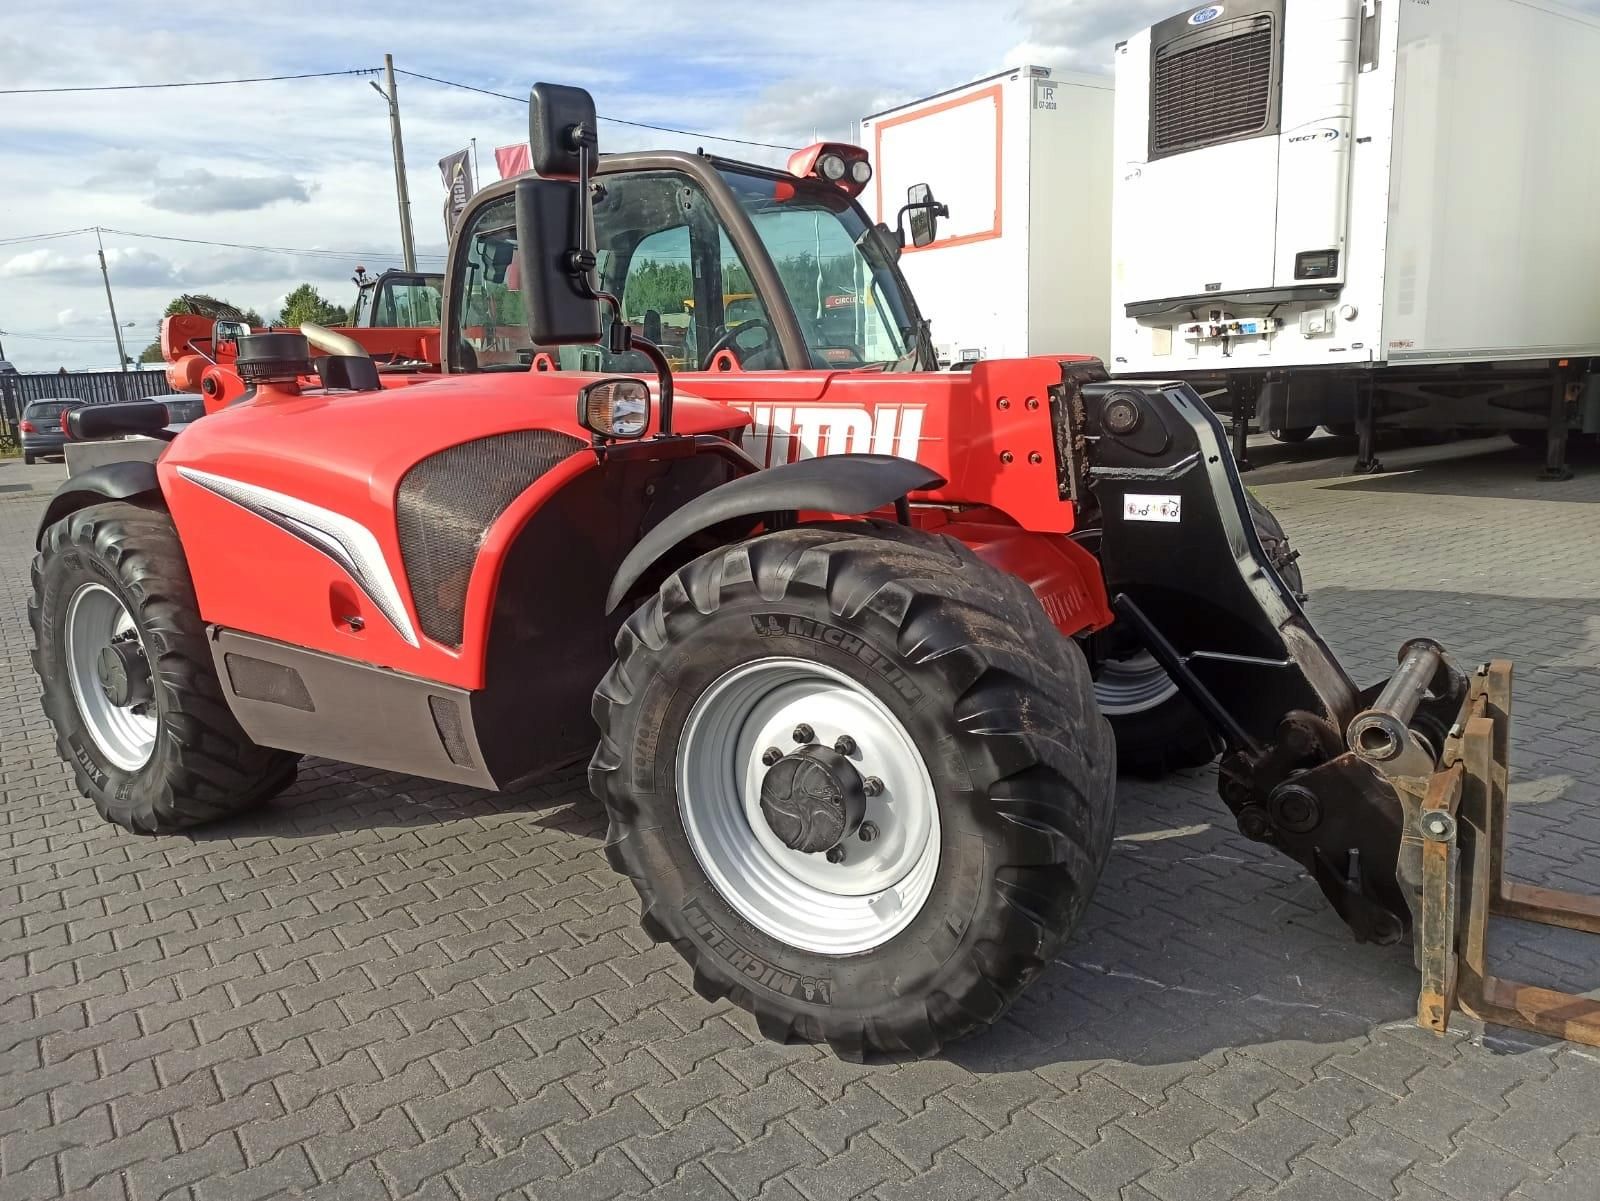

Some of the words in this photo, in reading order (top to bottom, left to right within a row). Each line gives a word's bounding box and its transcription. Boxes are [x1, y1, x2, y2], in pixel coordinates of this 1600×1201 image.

[1043, 87, 1054, 100] IR
[1289, 132, 1333, 143] VECTR
[788, 616, 922, 700] MICHELIN
[76, 744, 103, 784] XMCL
[681, 906, 799, 996] MICHELIN
